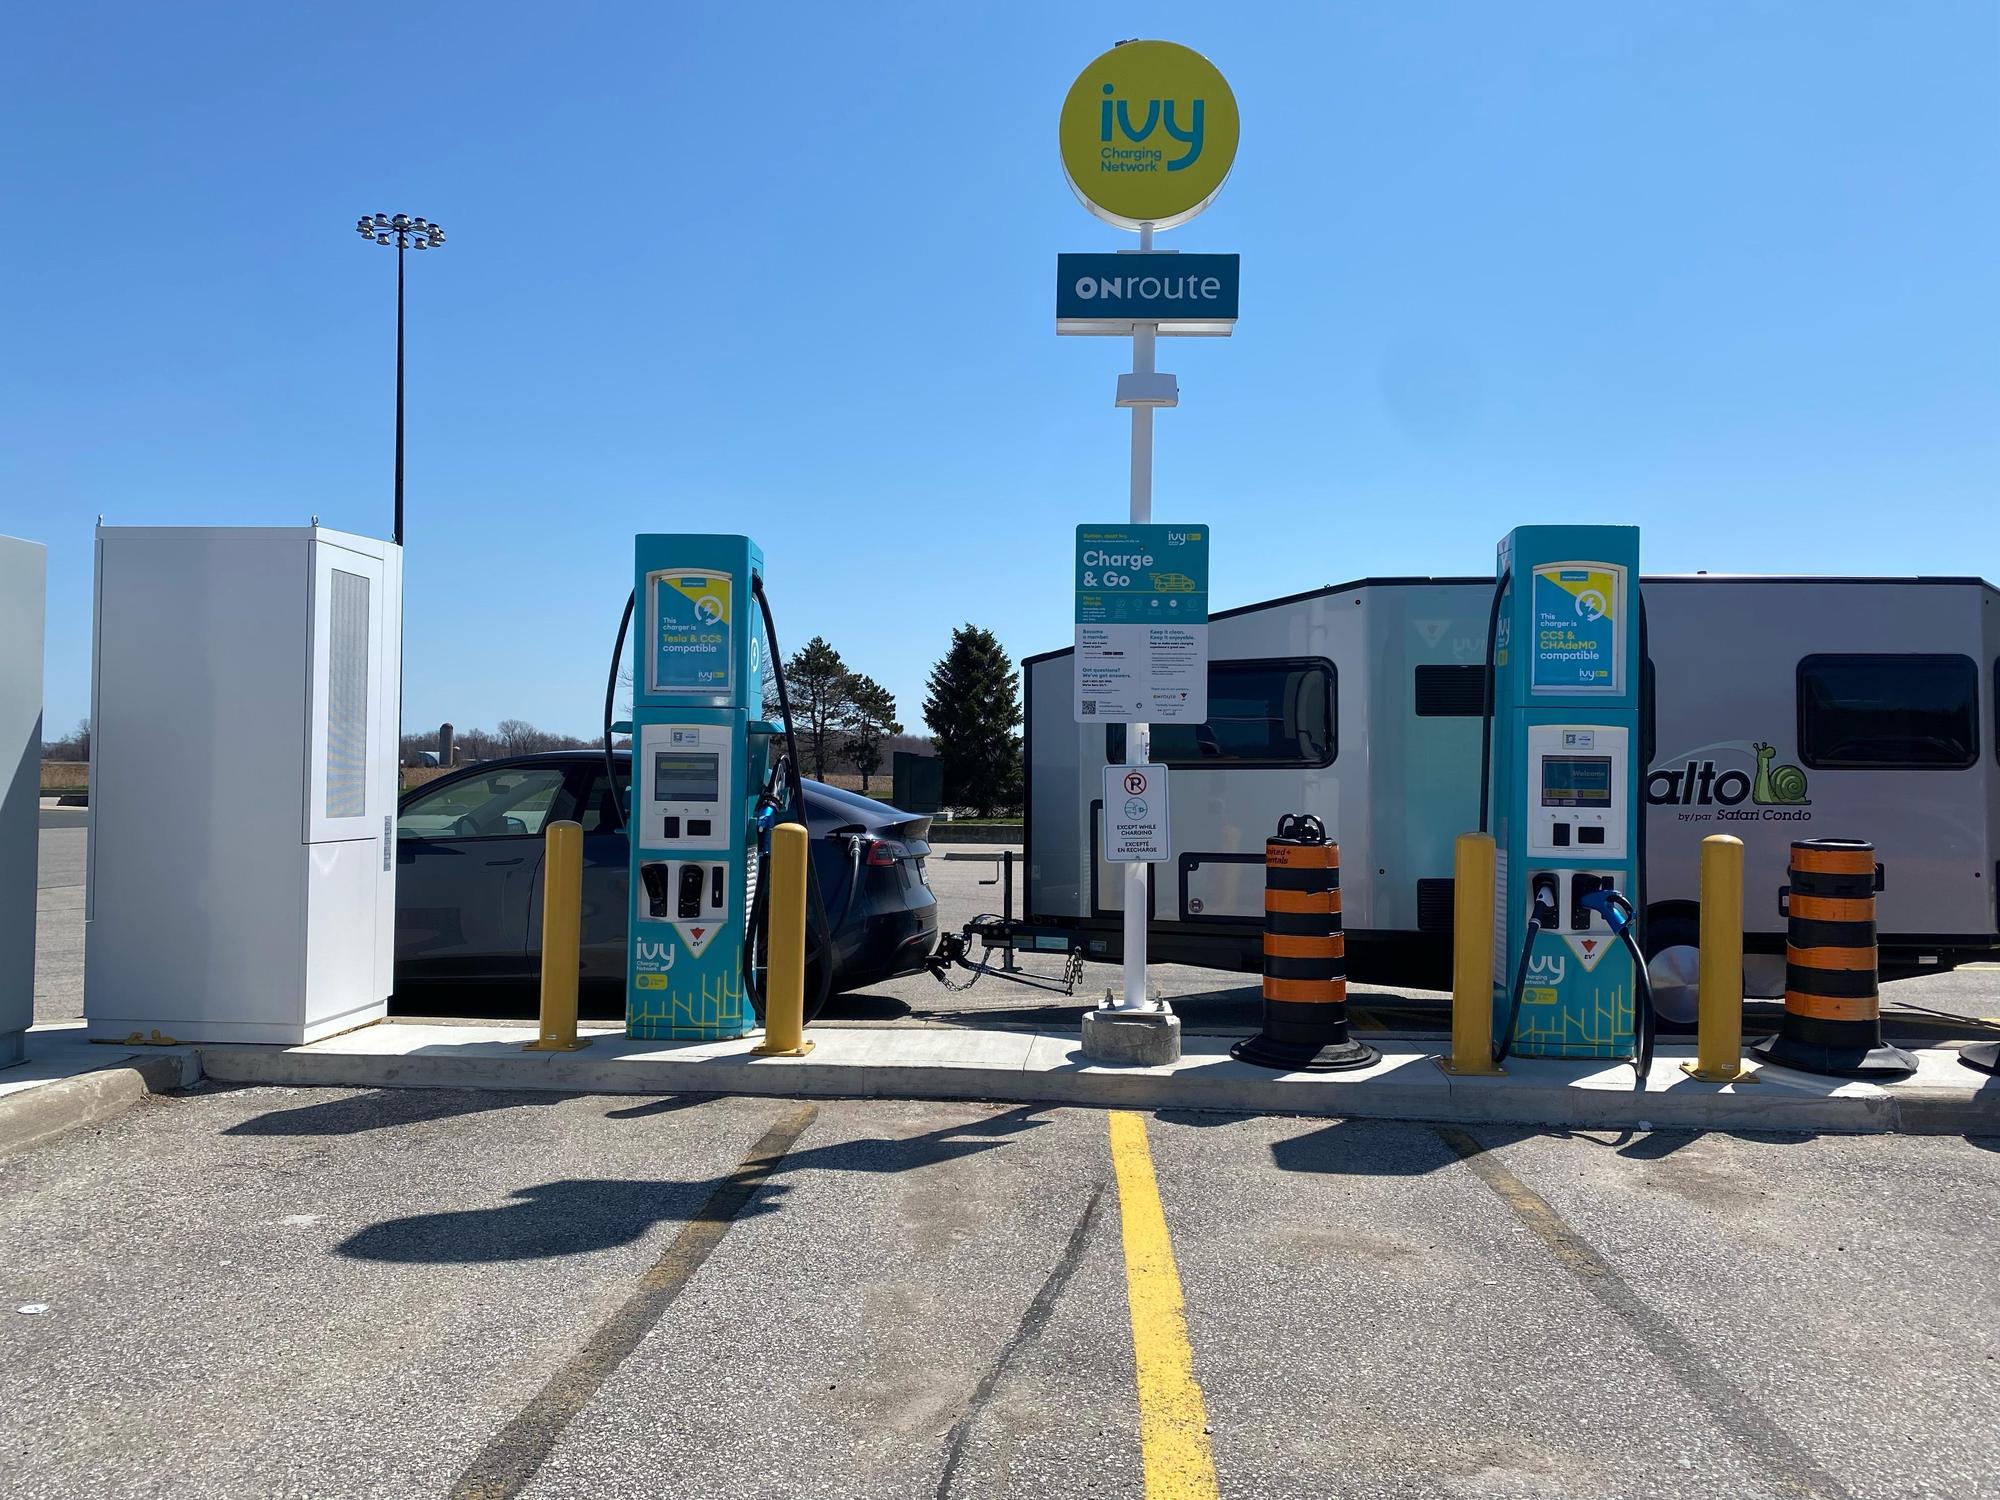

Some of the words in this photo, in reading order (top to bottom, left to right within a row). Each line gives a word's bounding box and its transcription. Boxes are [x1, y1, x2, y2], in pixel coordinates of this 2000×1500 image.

[1101, 83, 1204, 172] ivy
[1101, 147, 1162, 161] Charging
[1101, 161, 1157, 172] Network
[1168, 530, 1186, 546] ivy
[1083, 550, 1153, 571] Charge
[1083, 571, 1098, 587] &
[1103, 571, 1130, 587] Go
[663, 624, 689, 632] charger
[663, 634, 687, 643] Tesla
[690, 635, 697, 643] &
[700, 634, 722, 643] CCS
[1540, 631, 1564, 640] CCS
[1567, 631, 1575, 640] &
[662, 643, 717, 654] compatible
[1540, 641, 1597, 650] CHAdeMO
[1540, 651, 1599, 661] compatible
[698, 671, 713, 682] ivy
[1579, 668, 1595, 681] ivy
[1647, 761, 1751, 806] alto
[1678, 812, 1712, 822] by/par
[1716, 809, 1760, 821] Safari
[1763, 810, 1812, 821] Condo
[636, 936, 675, 972] ivy
[1529, 955, 1565, 985] vy
[1526, 974, 1548, 982] harging
